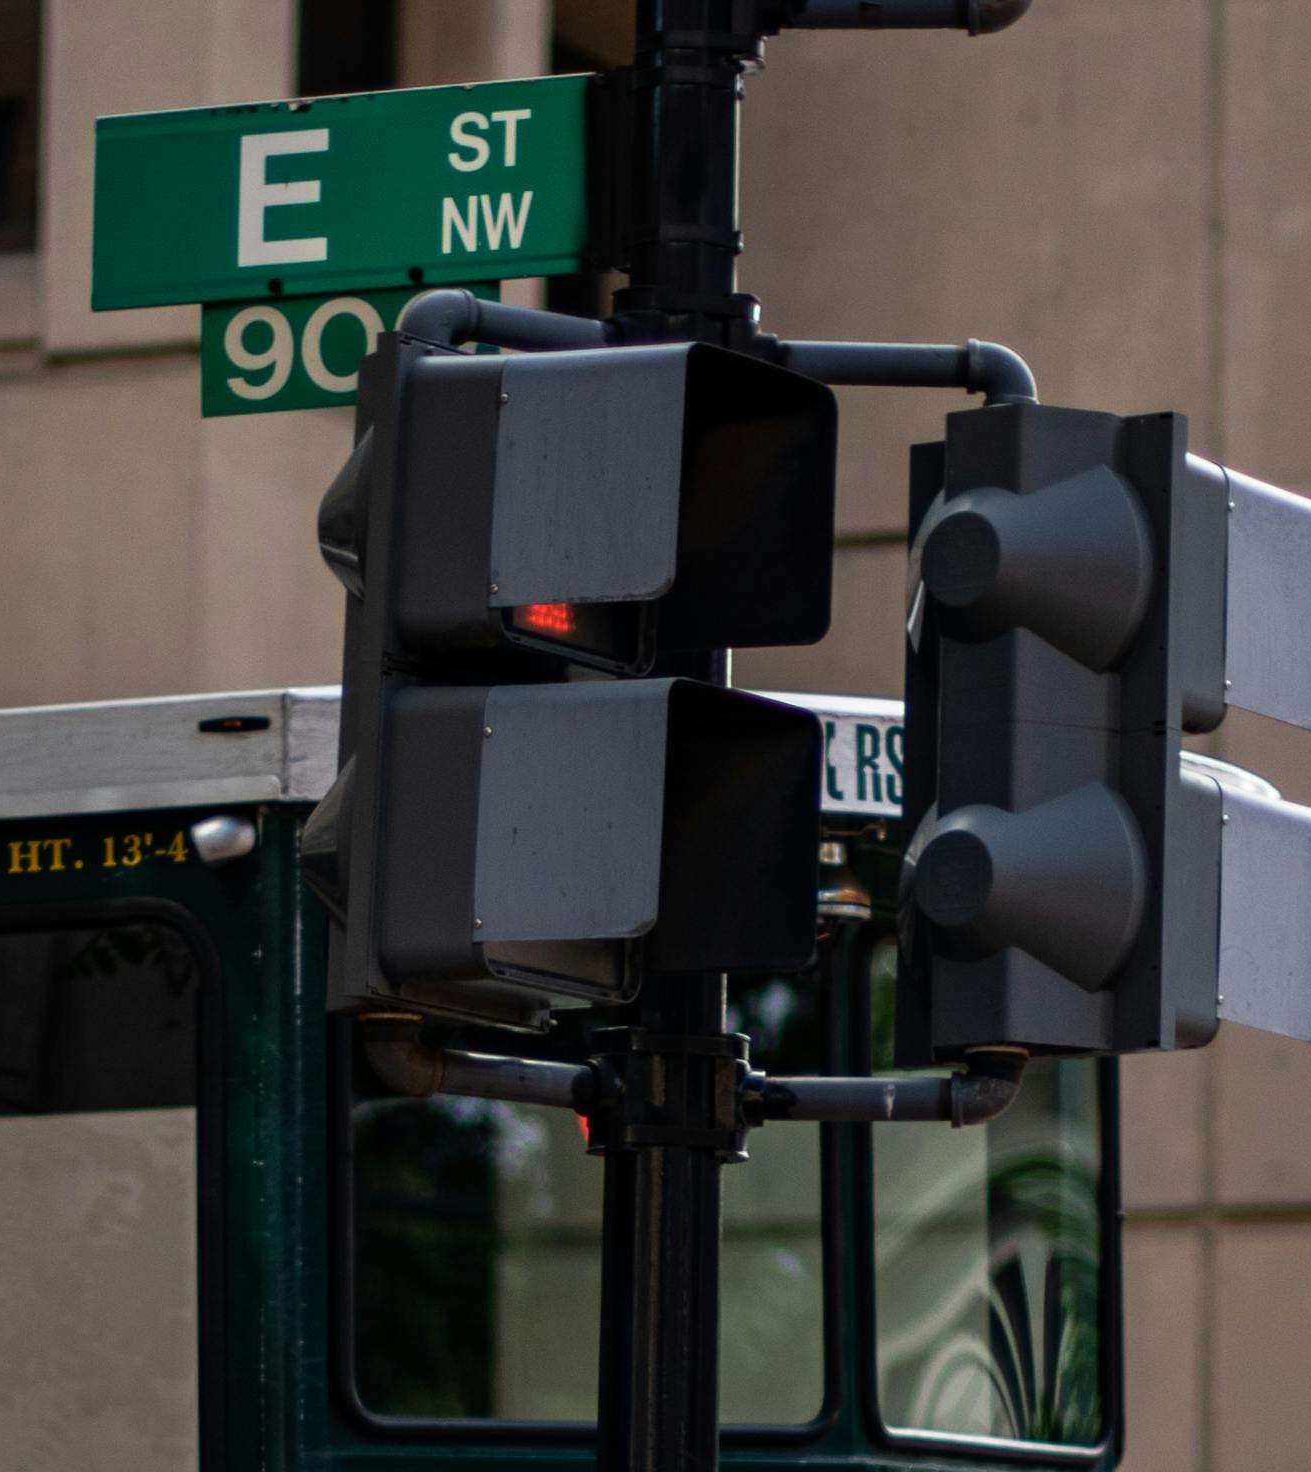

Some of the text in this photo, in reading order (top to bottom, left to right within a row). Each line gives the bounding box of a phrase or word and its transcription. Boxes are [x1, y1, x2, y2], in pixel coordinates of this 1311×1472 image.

[447, 108, 533, 173] ST
[237, 128, 330, 268] E
[440, 190, 534, 254] NW
[224, 294, 476, 400] 90
[8, 839, 85, 874] HT.
